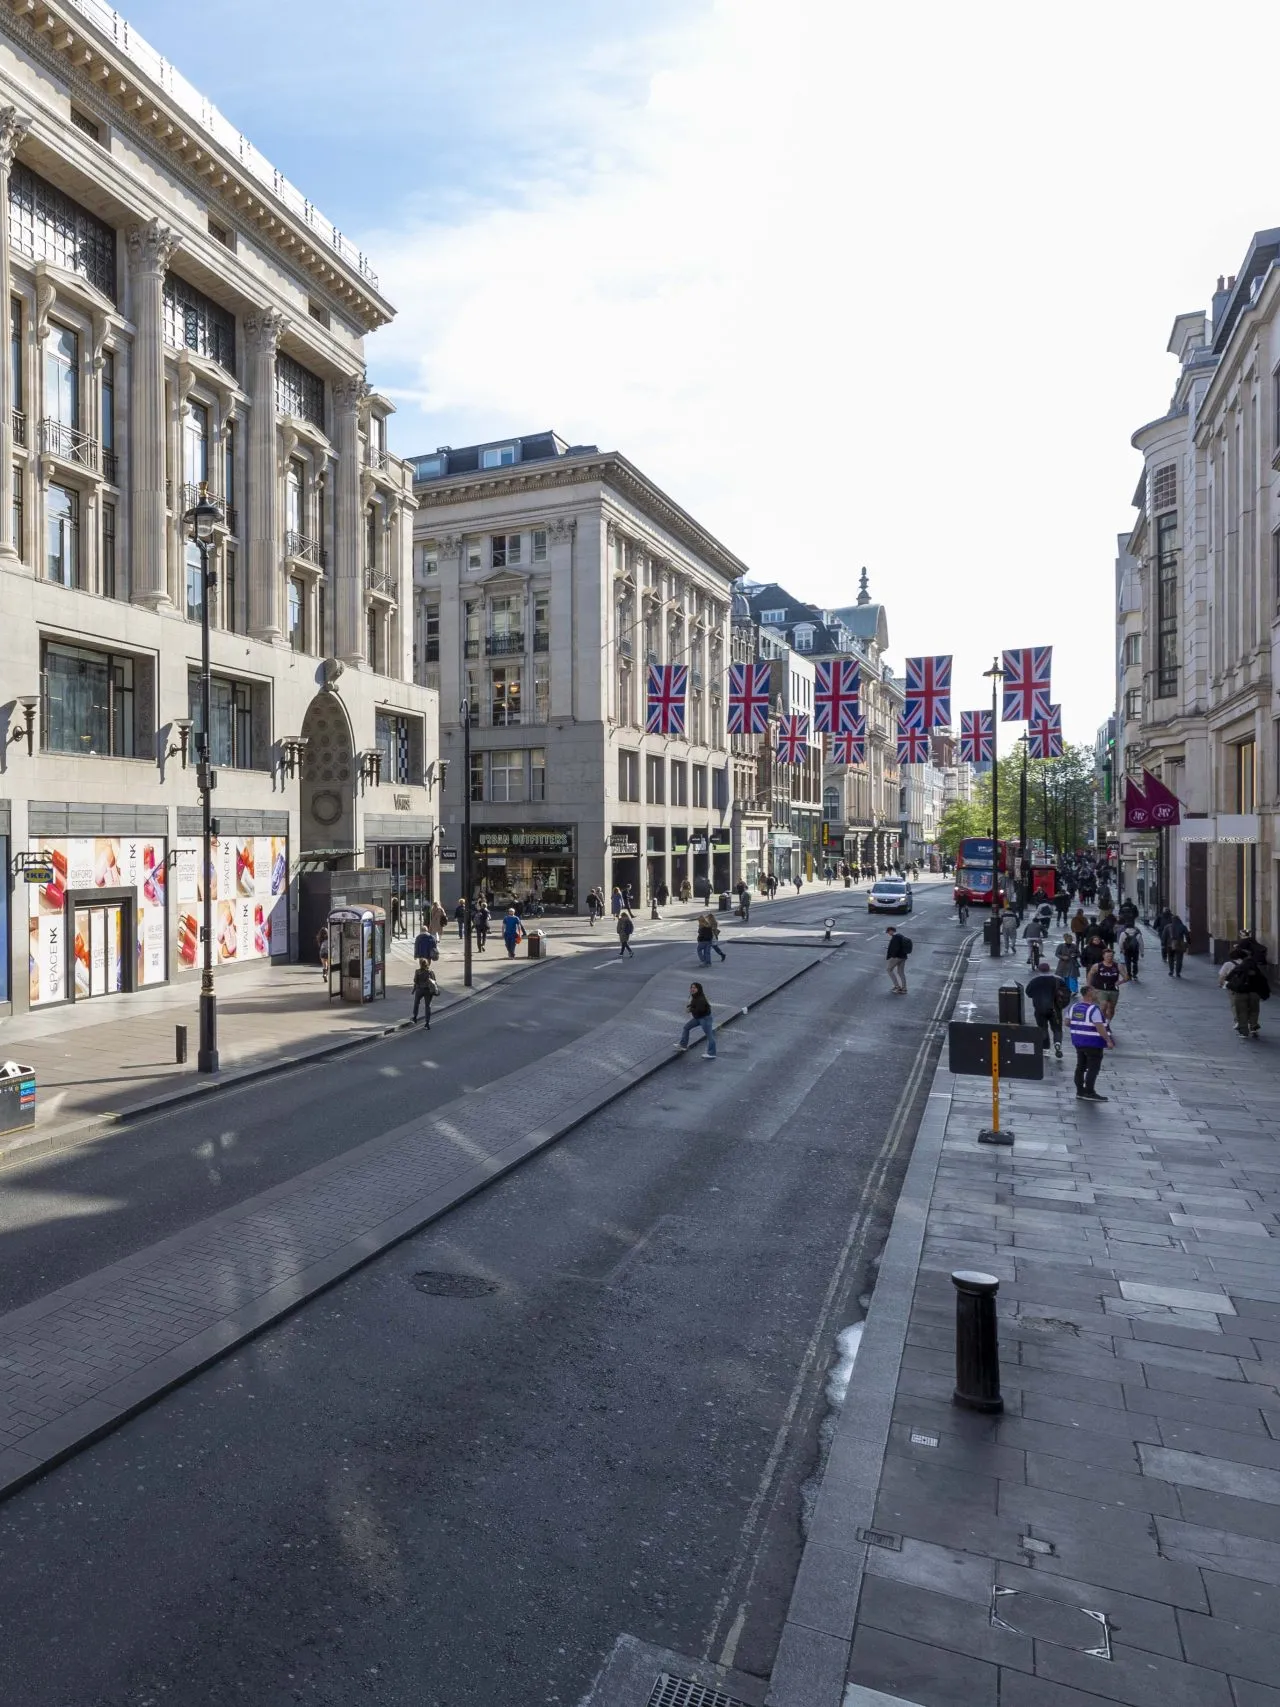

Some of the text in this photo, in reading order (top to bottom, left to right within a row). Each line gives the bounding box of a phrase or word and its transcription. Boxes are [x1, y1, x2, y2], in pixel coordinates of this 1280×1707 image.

[479, 833, 568, 845] URBAN OUTFITTERS
[26, 872, 51, 880] IKEA
[49, 927, 58, 944] NK
